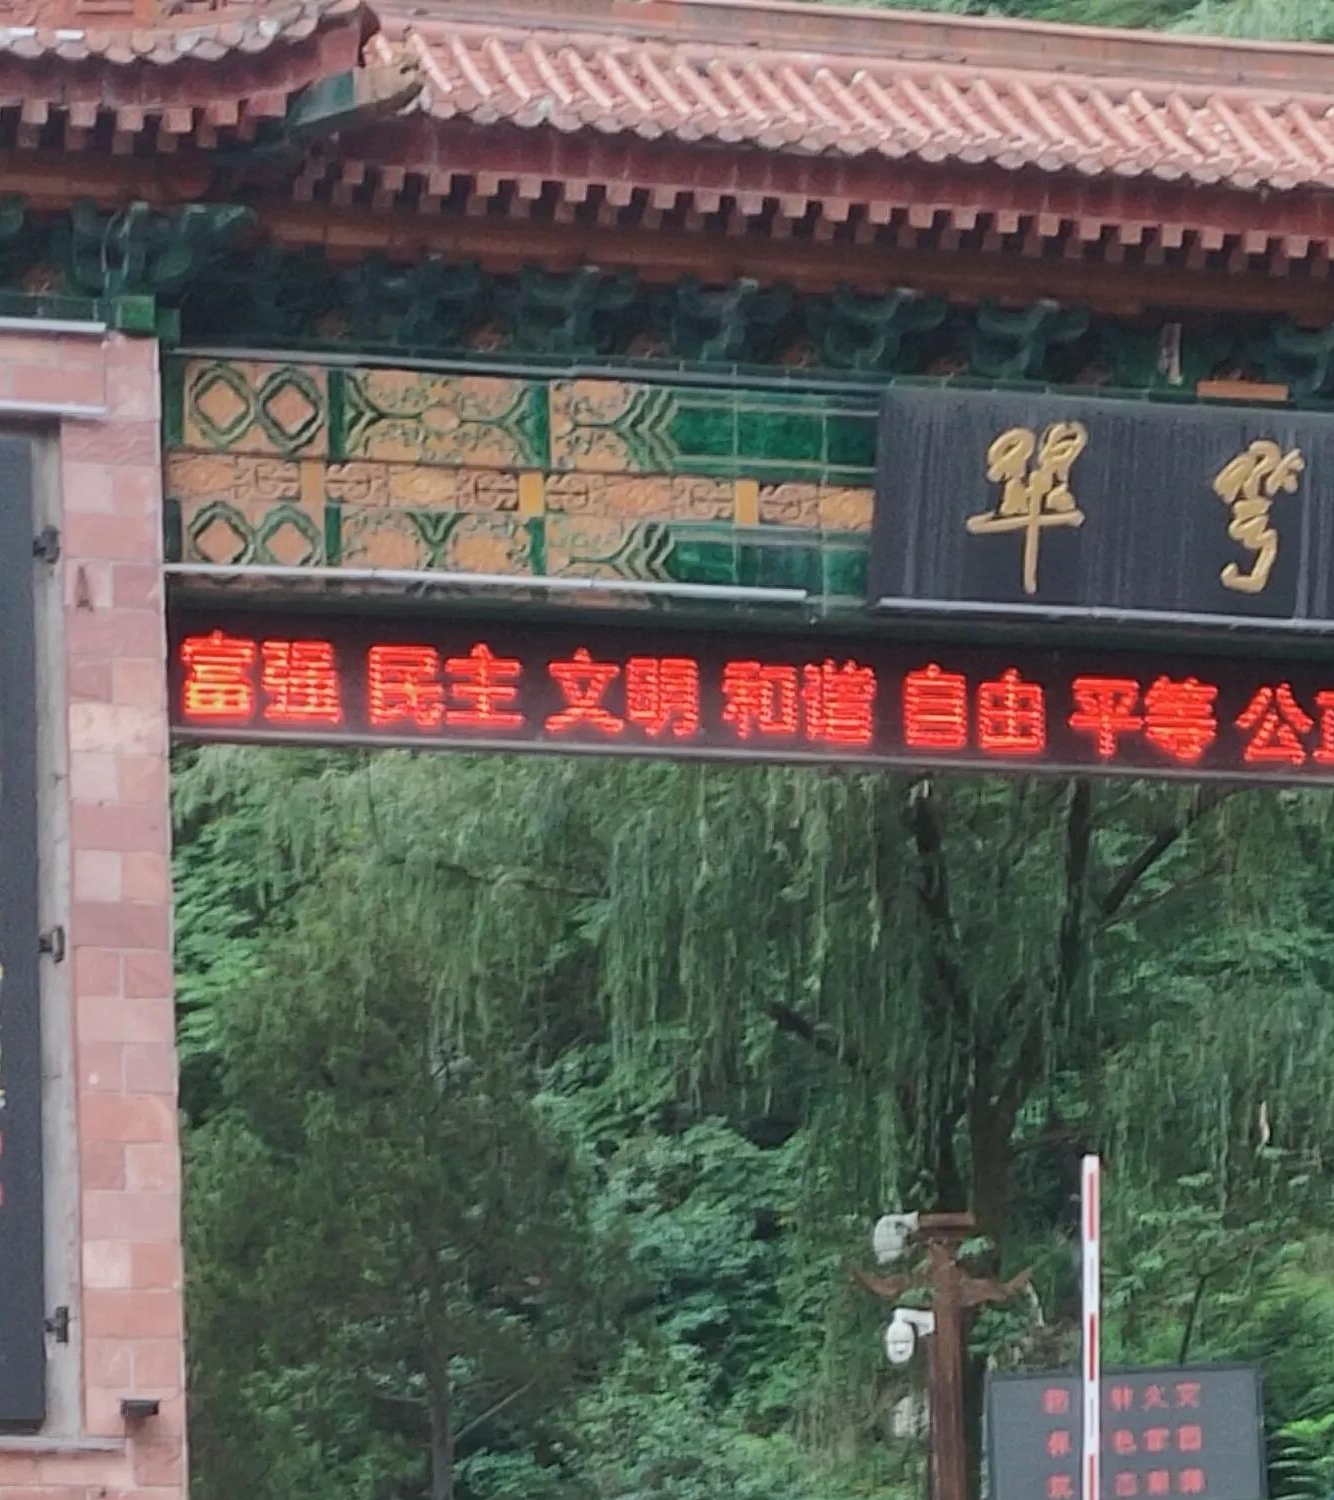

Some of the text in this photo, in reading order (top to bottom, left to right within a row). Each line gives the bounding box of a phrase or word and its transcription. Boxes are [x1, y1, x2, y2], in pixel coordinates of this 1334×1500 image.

[367, 642, 525, 731] 民主
[545, 648, 700, 738] 文明
[722, 659, 877, 747] 和谐
[903, 662, 1046, 755] 自由
[1068, 675, 1219, 762] 平等
